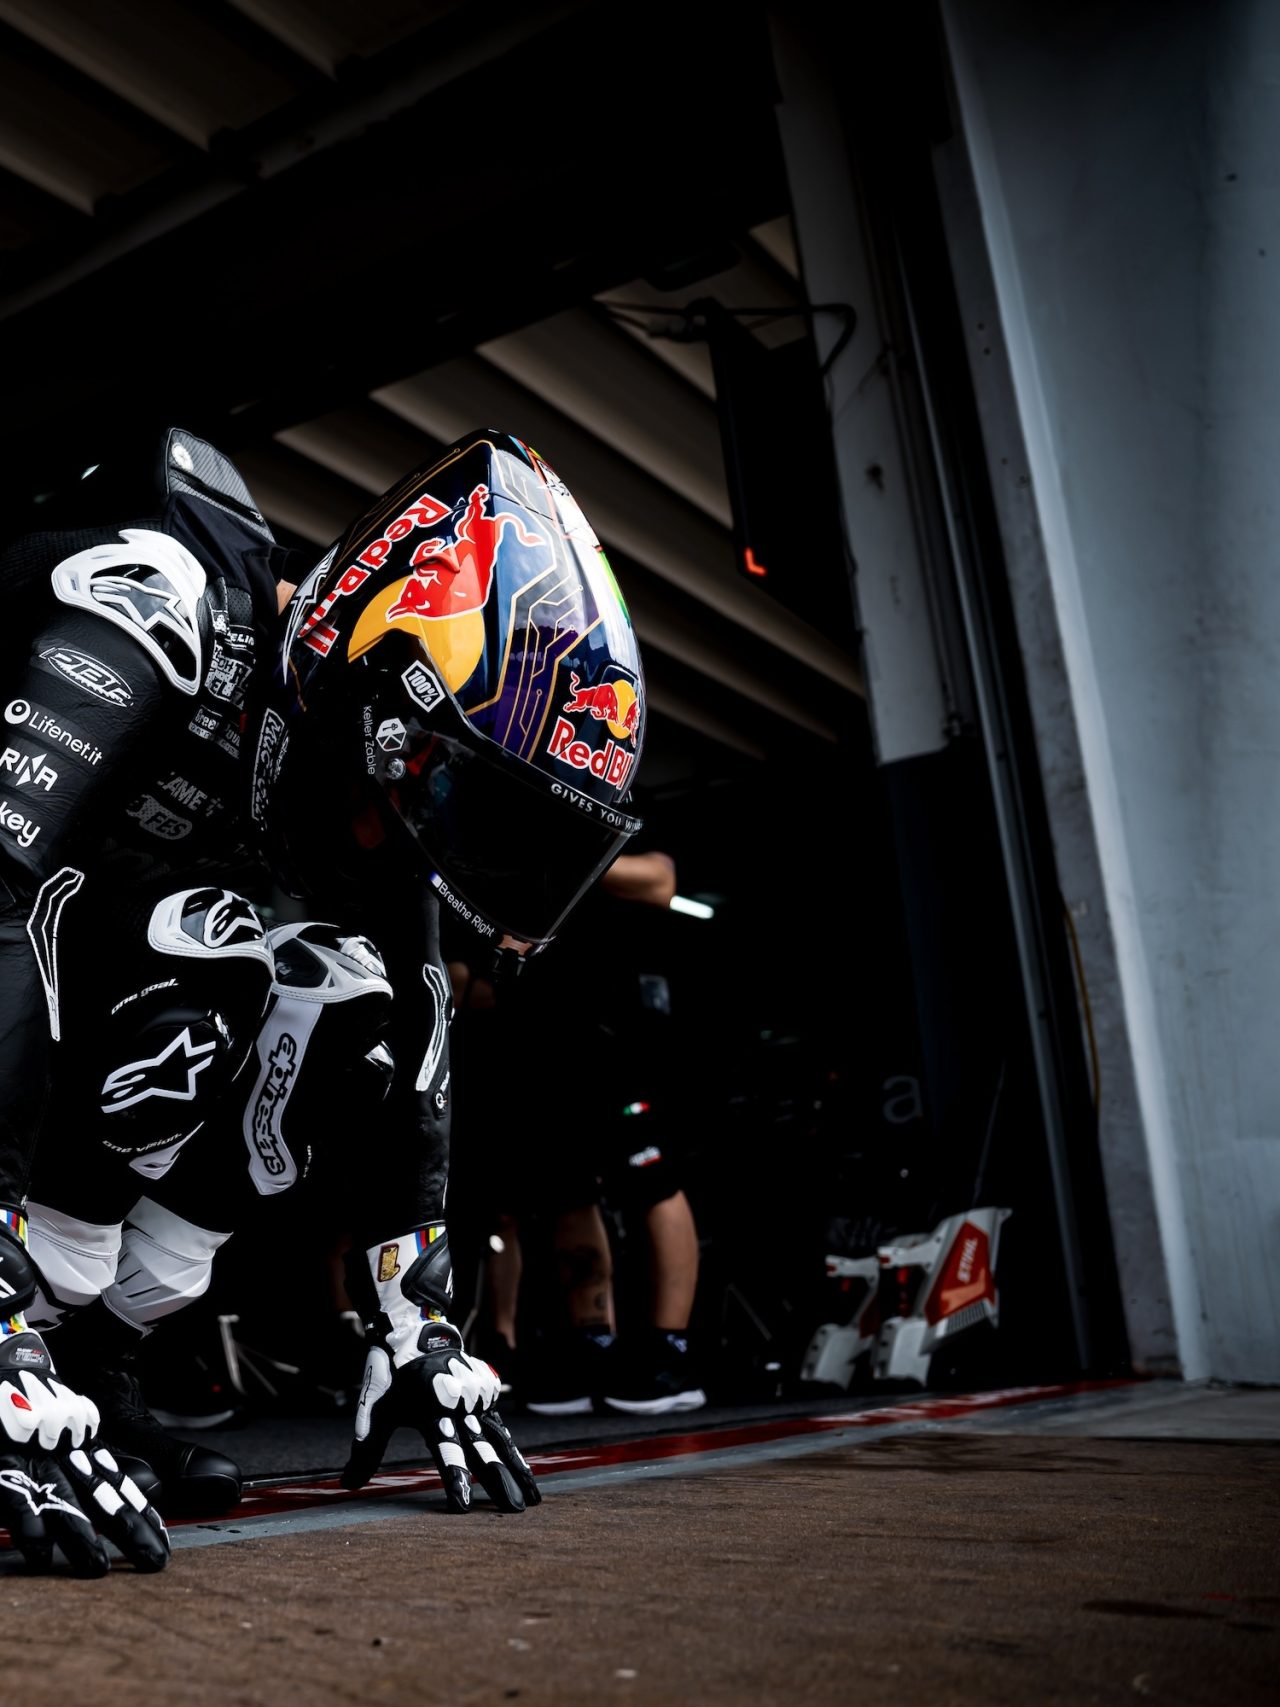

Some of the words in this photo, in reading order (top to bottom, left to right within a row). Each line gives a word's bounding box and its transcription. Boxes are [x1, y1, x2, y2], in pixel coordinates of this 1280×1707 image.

[356, 493, 453, 571] Red
[407, 669, 440, 704] 100%
[28, 711, 103, 766] Lifenet.it
[546, 715, 614, 781] Red
[550, 782, 594, 813] GIVES
[600, 808, 622, 827] YOU
[437, 881, 472, 920] Breathe
[470, 914, 497, 938] Right
